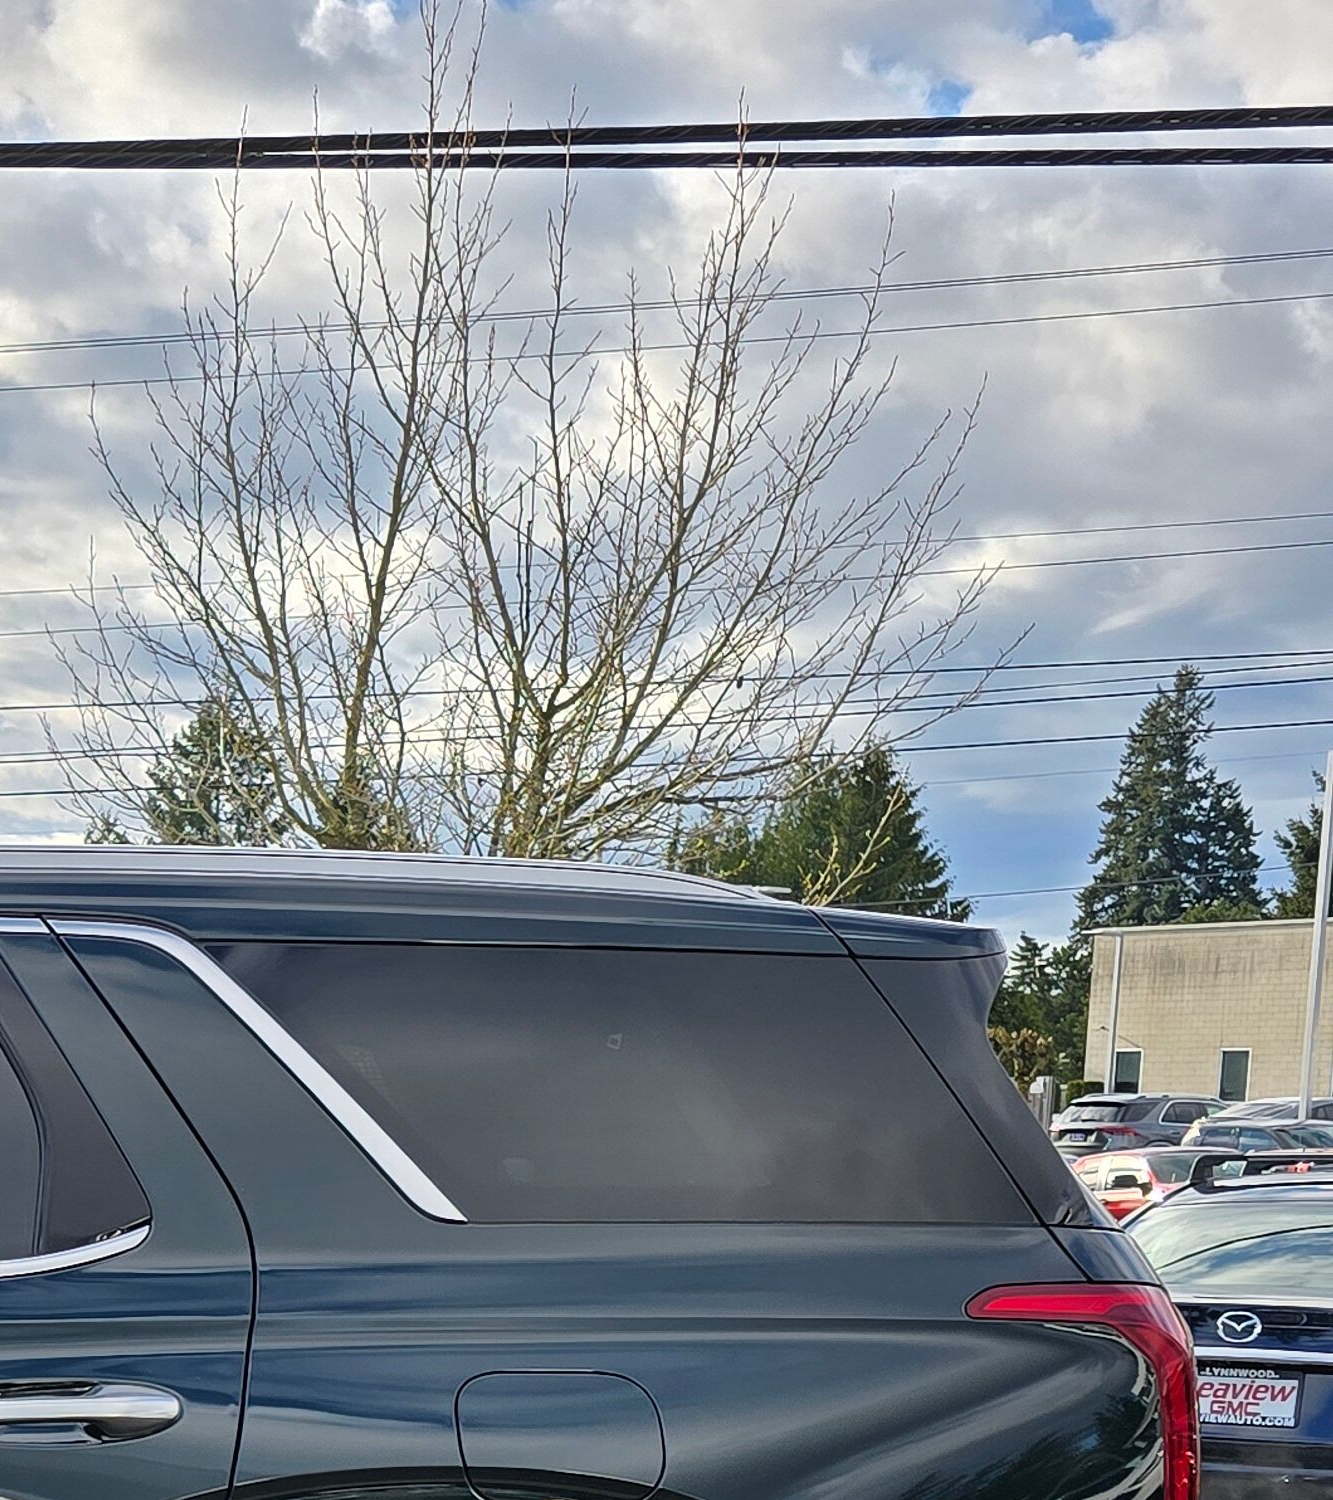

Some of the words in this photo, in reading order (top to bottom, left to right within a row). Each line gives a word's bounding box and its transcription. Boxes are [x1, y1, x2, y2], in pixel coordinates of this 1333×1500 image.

[1205, 1367, 1276, 1378] LYNNWOOD
[1197, 1380, 1296, 1402] eaview
[1210, 1400, 1262, 1417] GMC
[1200, 1413, 1295, 1427] VIEWAUTO.COM
